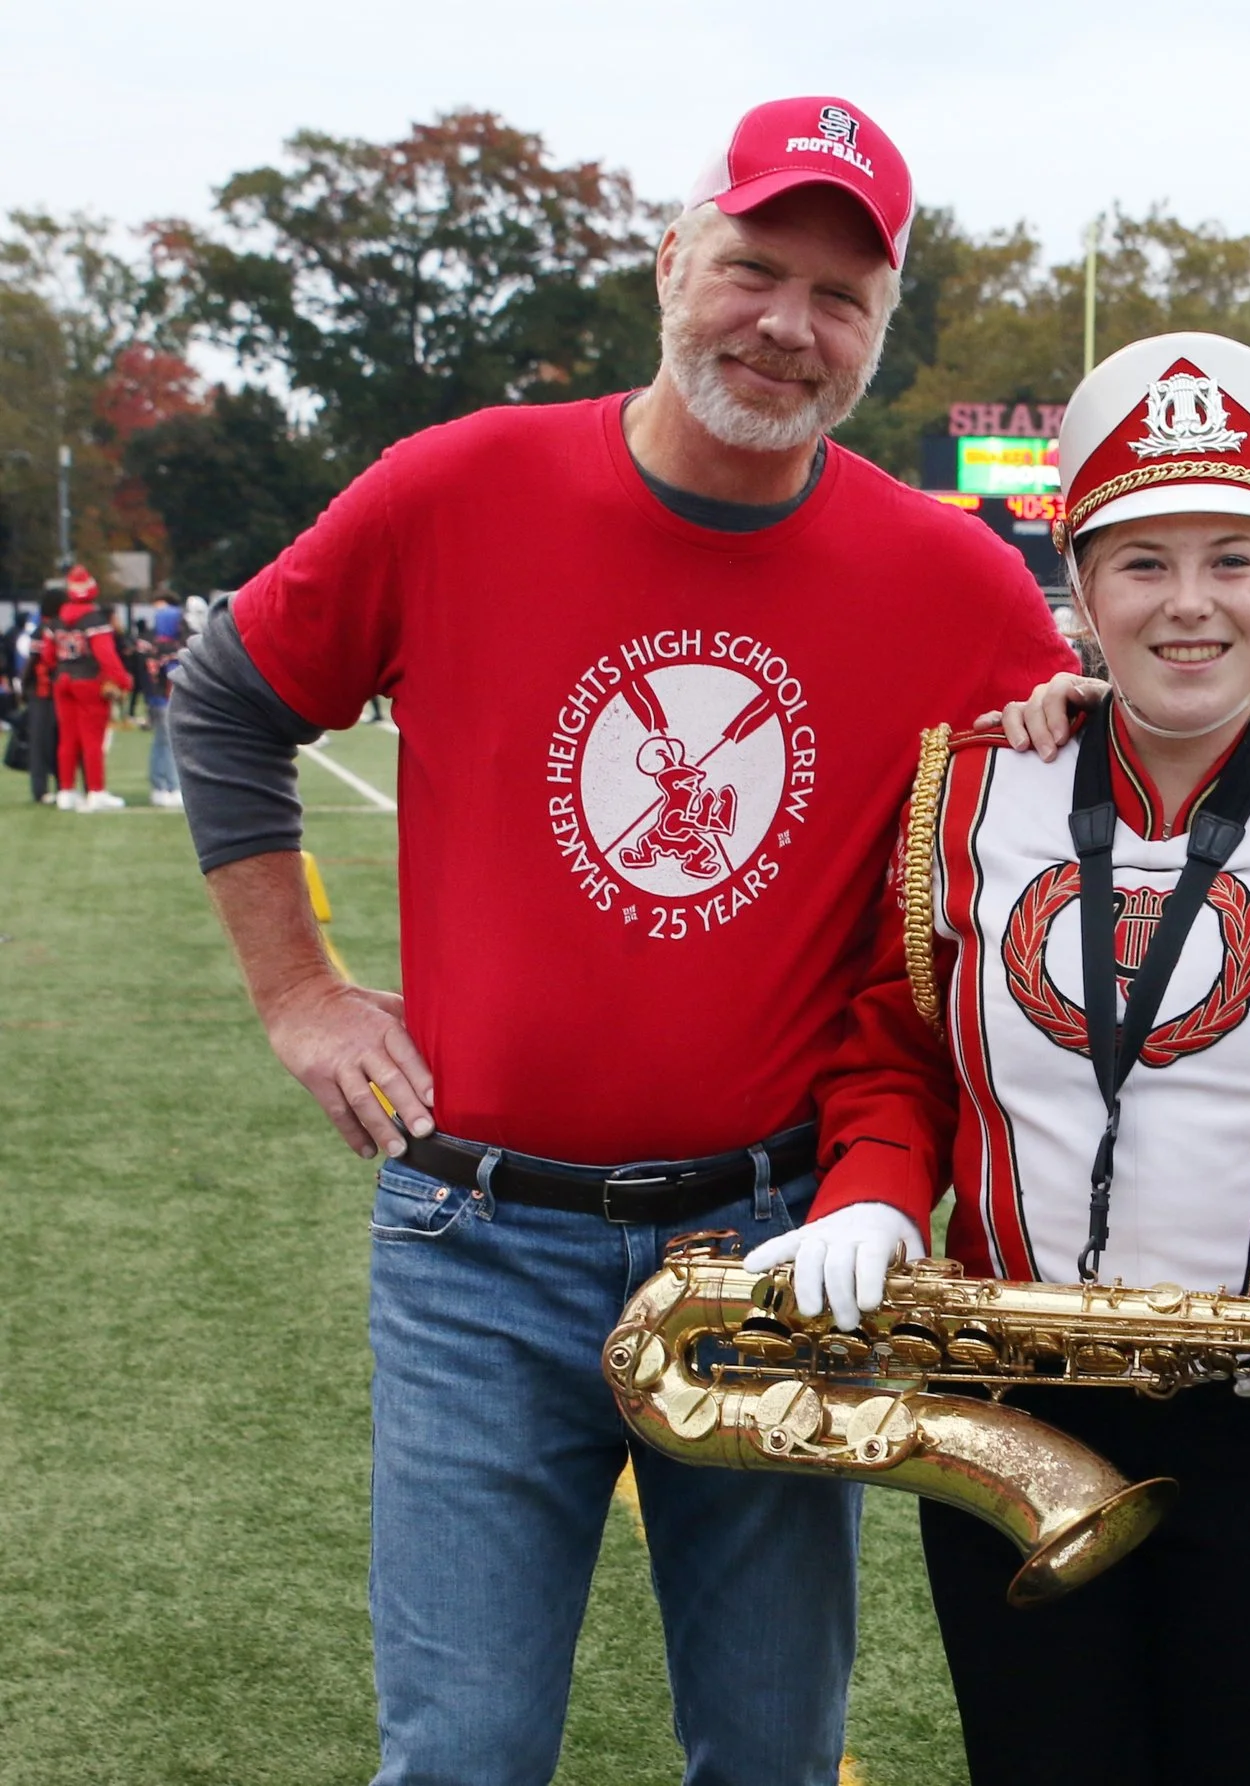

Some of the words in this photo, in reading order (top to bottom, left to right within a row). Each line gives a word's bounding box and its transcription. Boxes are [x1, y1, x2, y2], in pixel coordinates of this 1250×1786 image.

[785, 136, 874, 178] FOOTBALL
[619, 628, 702, 671] HIGH
[709, 630, 808, 723] SCHOOL
[546, 655, 622, 784] HEIGHTS
[784, 725, 817, 823] CREW
[548, 792, 621, 912] SHAKER
[647, 906, 688, 940] 25
[694, 853, 780, 931] YEARS
